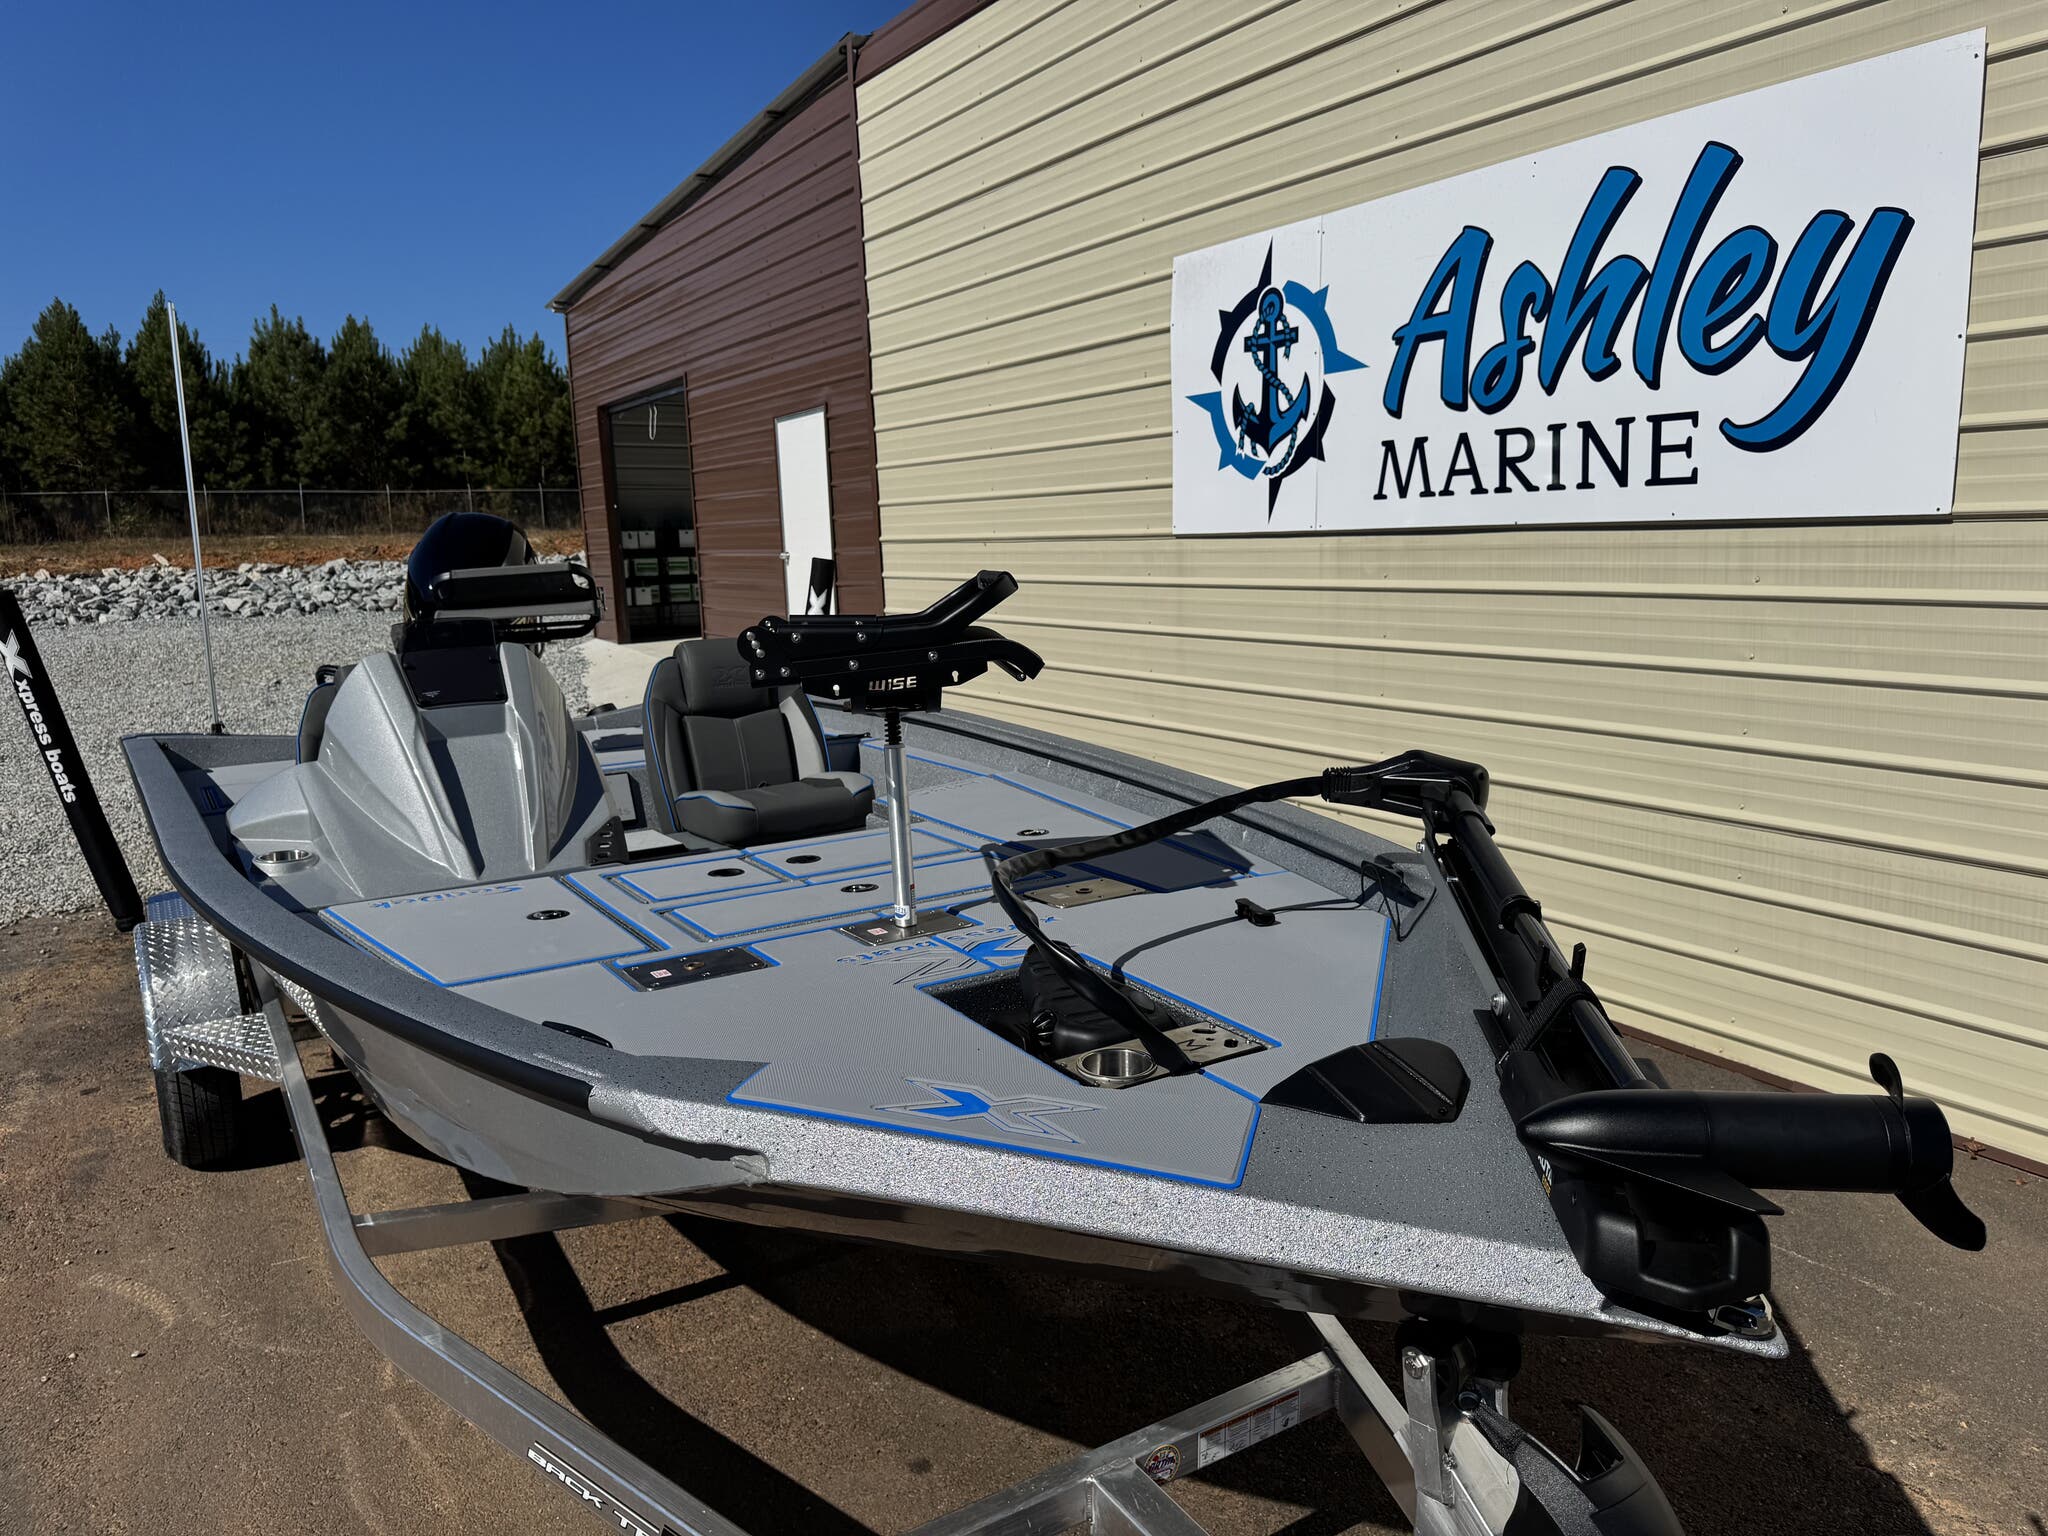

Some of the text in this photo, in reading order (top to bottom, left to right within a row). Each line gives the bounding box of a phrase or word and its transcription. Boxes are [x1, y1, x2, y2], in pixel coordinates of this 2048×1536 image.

[1383, 140, 1915, 453] Ashley
[1373, 410, 1700, 500] MARINE
[868, 676, 917, 691] WISE
[15, 678, 52, 746] xpress
[44, 748, 77, 804] boats
[526, 1447, 604, 1510] BACK
